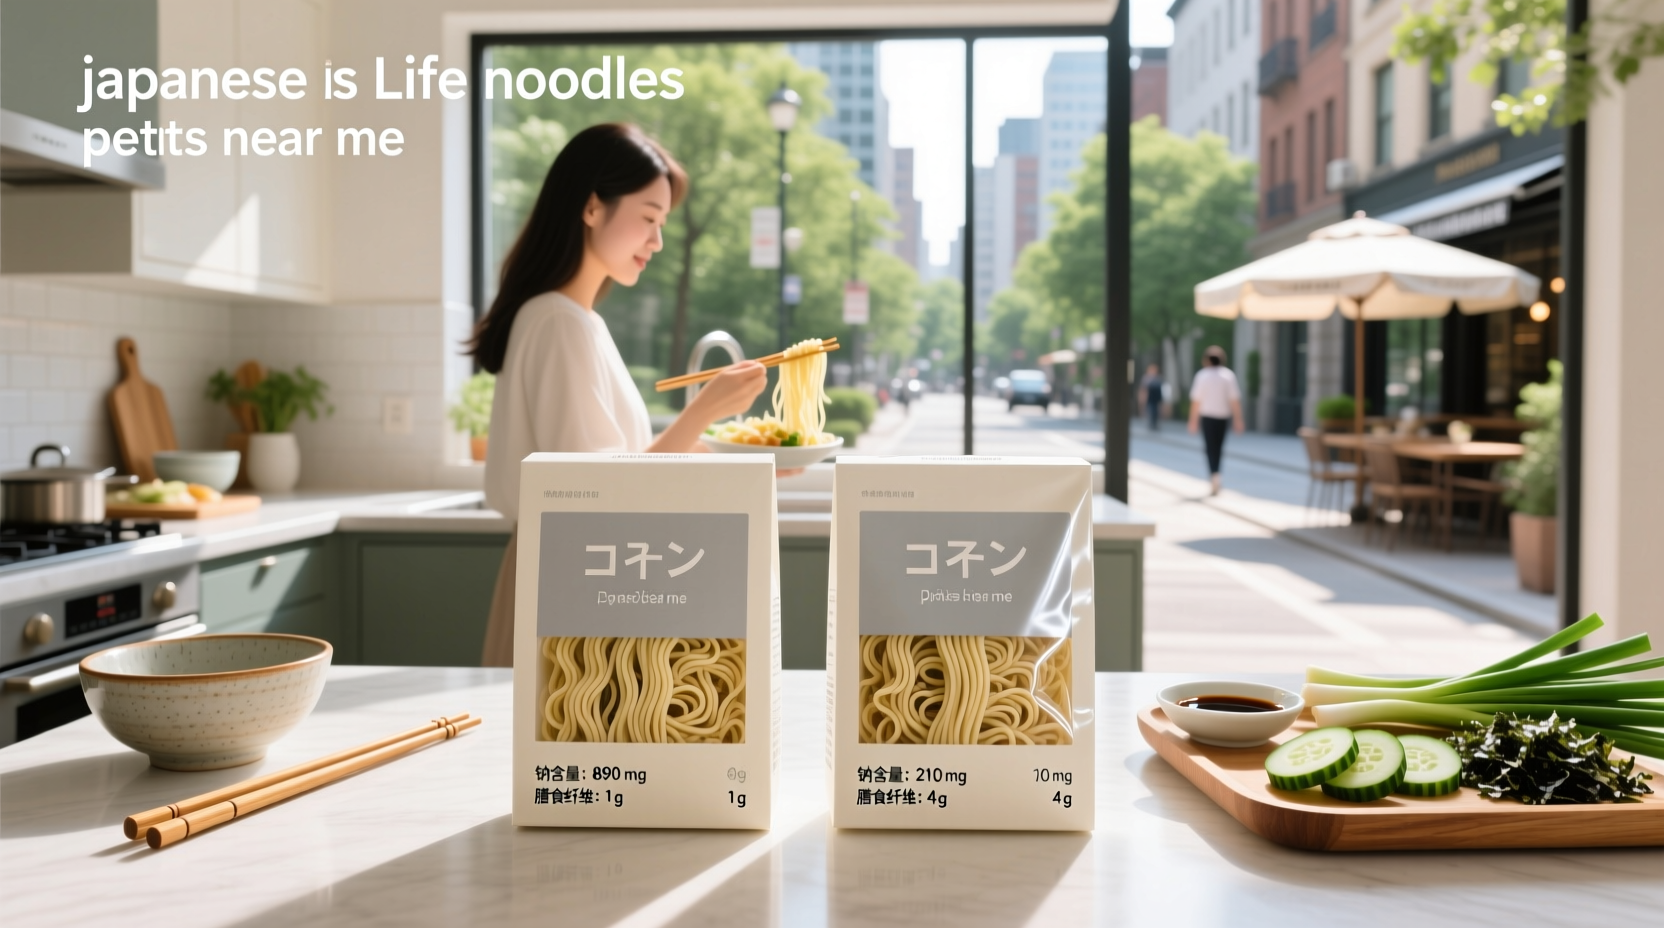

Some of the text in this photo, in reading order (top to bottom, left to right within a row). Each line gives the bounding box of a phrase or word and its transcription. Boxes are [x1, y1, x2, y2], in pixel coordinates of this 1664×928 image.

[592, 766, 621, 781] 890
[624, 770, 647, 785] mg
[916, 767, 943, 782] 210
[945, 772, 967, 786] mg
[1052, 772, 1073, 786] mg
[605, 789, 624, 807] 1g
[728, 790, 747, 808] 1g
[926, 790, 948, 808] 4g
[1052, 790, 1073, 808] 4g
